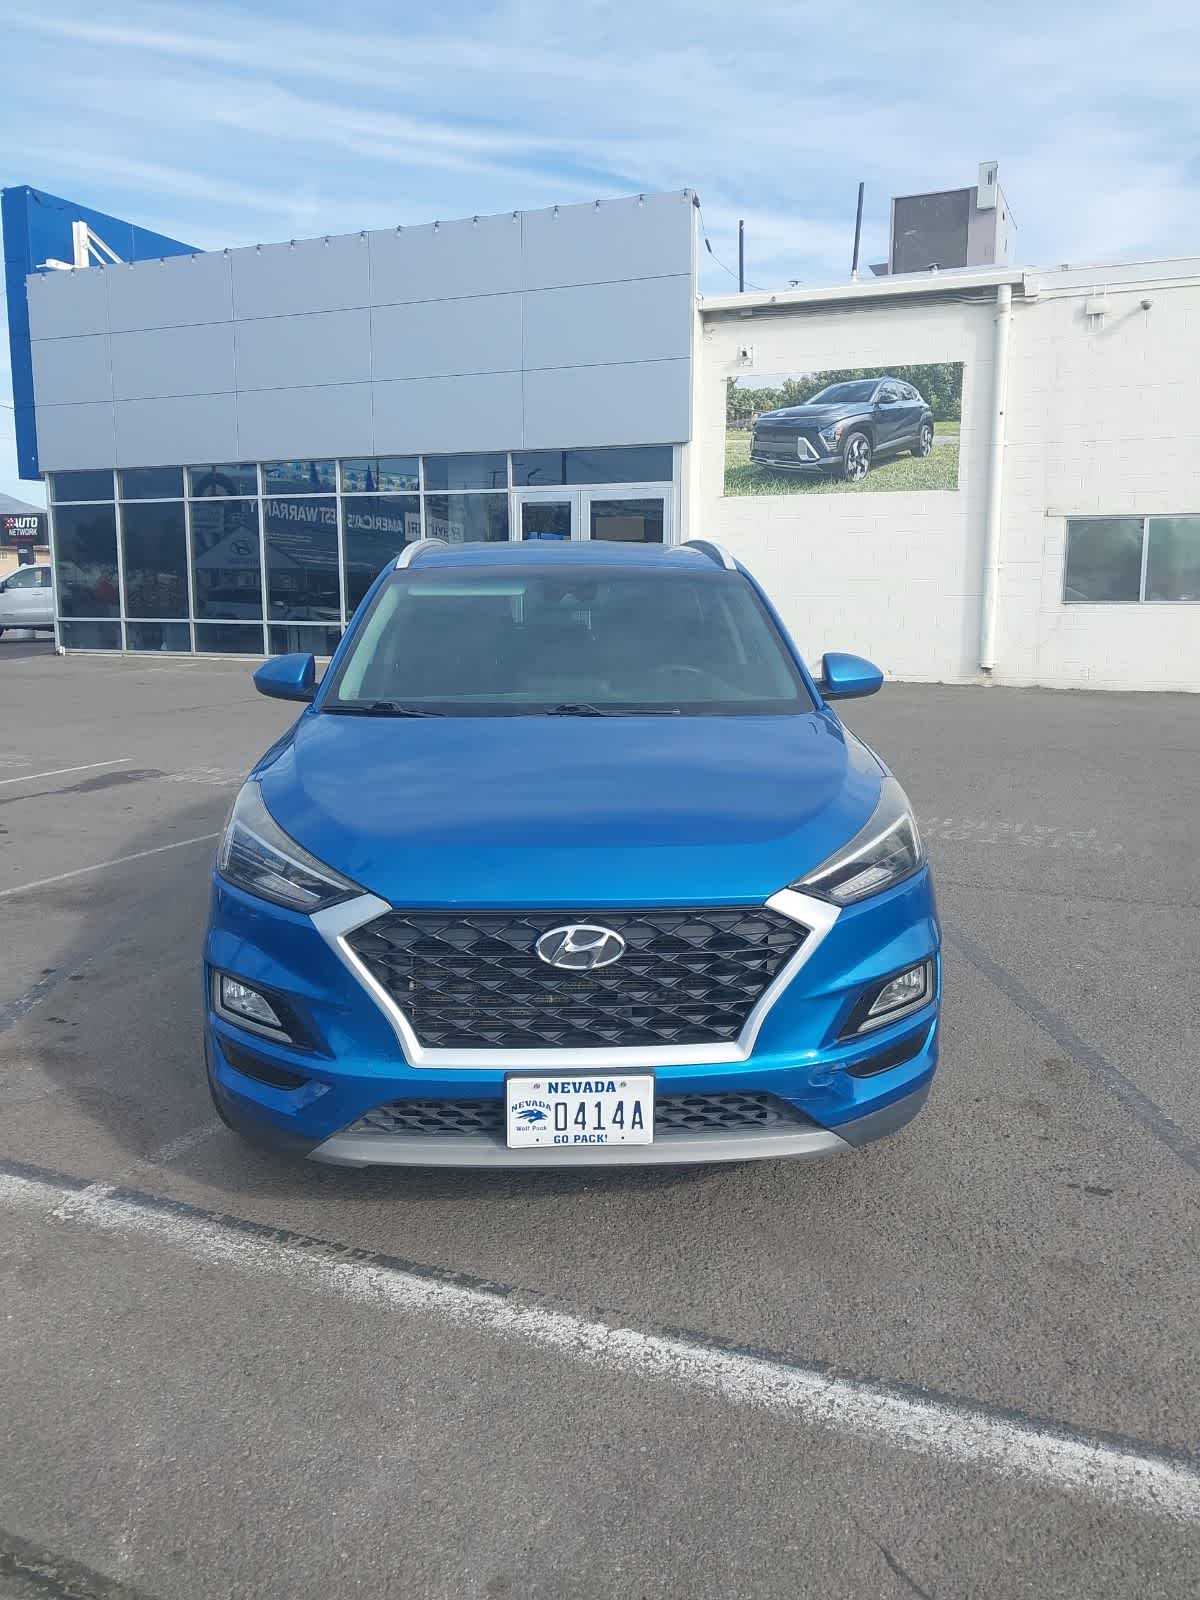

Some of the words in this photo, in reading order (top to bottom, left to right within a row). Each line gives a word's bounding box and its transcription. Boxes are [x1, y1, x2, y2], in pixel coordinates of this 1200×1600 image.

[14, 517, 38, 528] AUTO
[8, 528, 38, 536] NETWORK
[548, 1081, 616, 1094] NEVADA
[511, 1100, 552, 1112] NEVADA
[555, 1100, 644, 1131] 0414A
[554, 1135, 568, 1143] GO
[574, 1134, 608, 1143] PACK!
